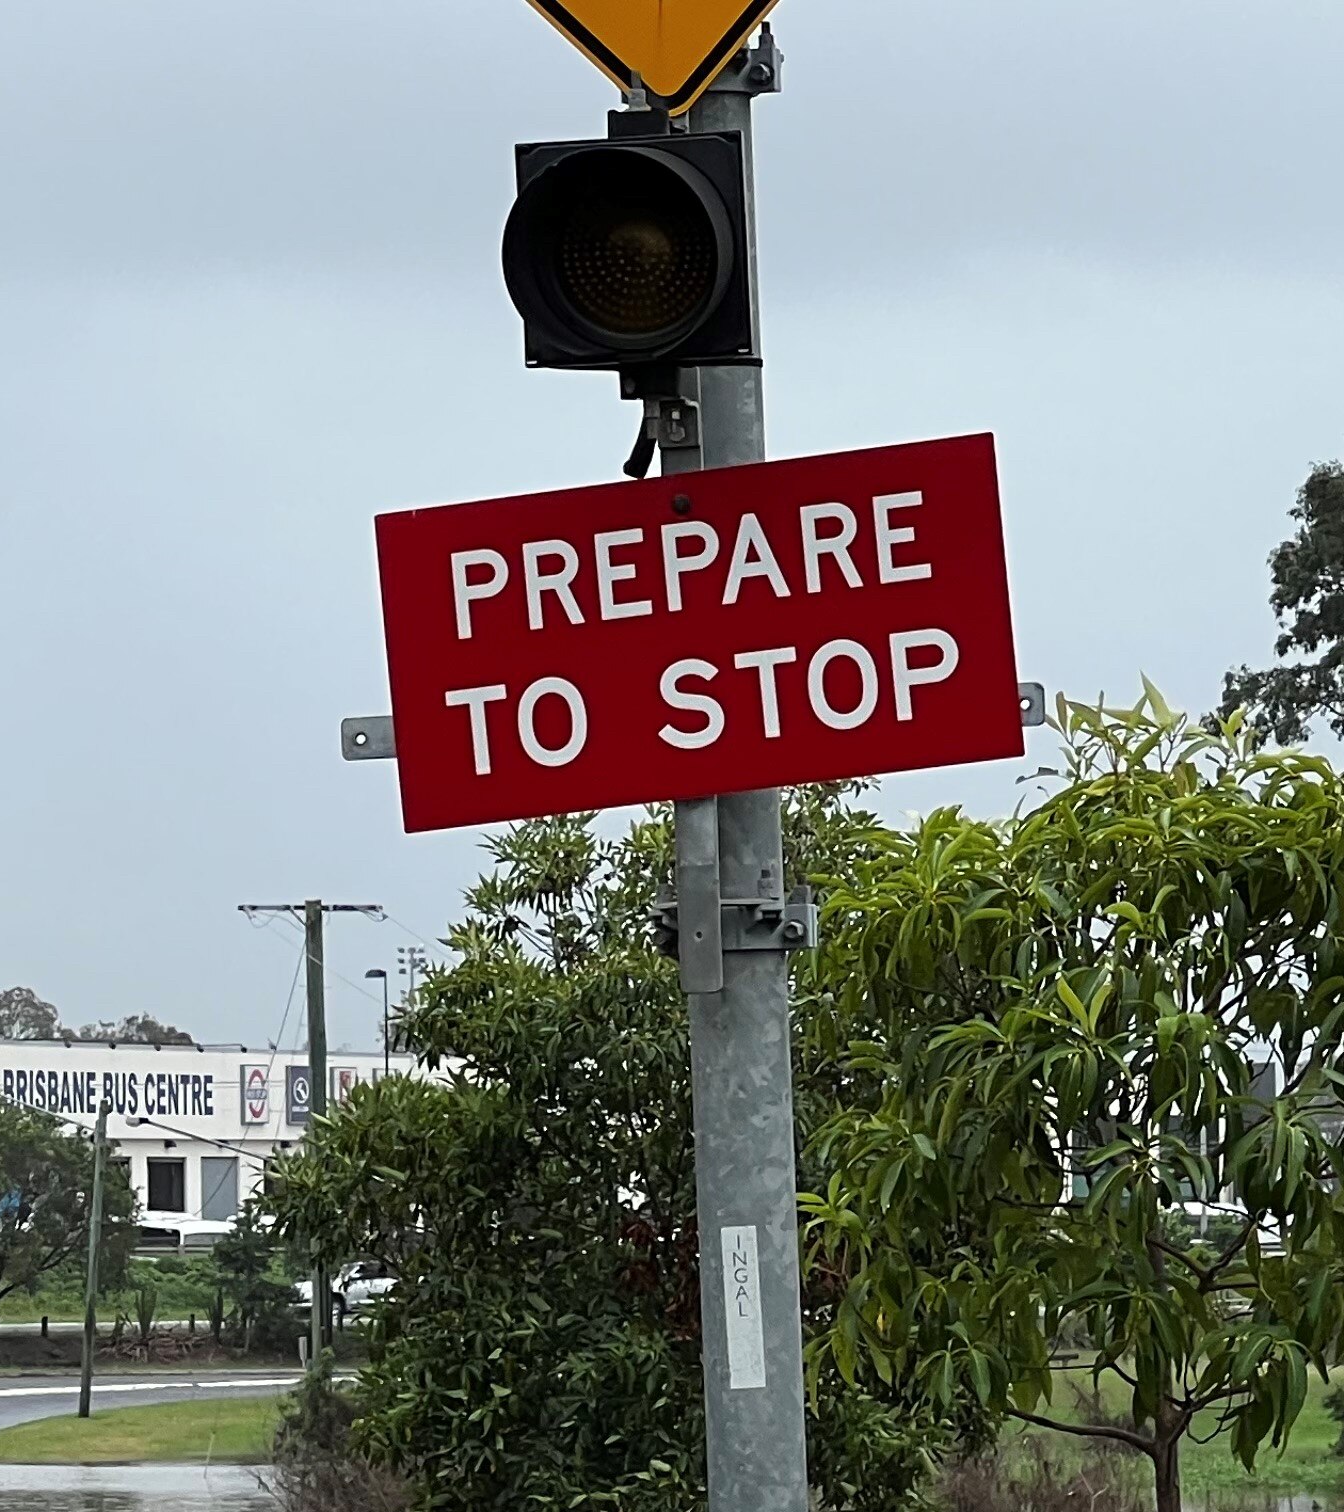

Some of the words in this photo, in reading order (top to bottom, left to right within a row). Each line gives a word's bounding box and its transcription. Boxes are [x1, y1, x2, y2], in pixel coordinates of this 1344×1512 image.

[450, 490, 932, 640] PREPARE
[444, 676, 587, 775] TO
[658, 628, 959, 750] STOP
[3, 1069, 96, 1114] BRISBANE
[103, 1072, 138, 1115] BUS
[144, 1073, 214, 1116] CENTRE
[732, 1234, 749, 1318] INGAL
